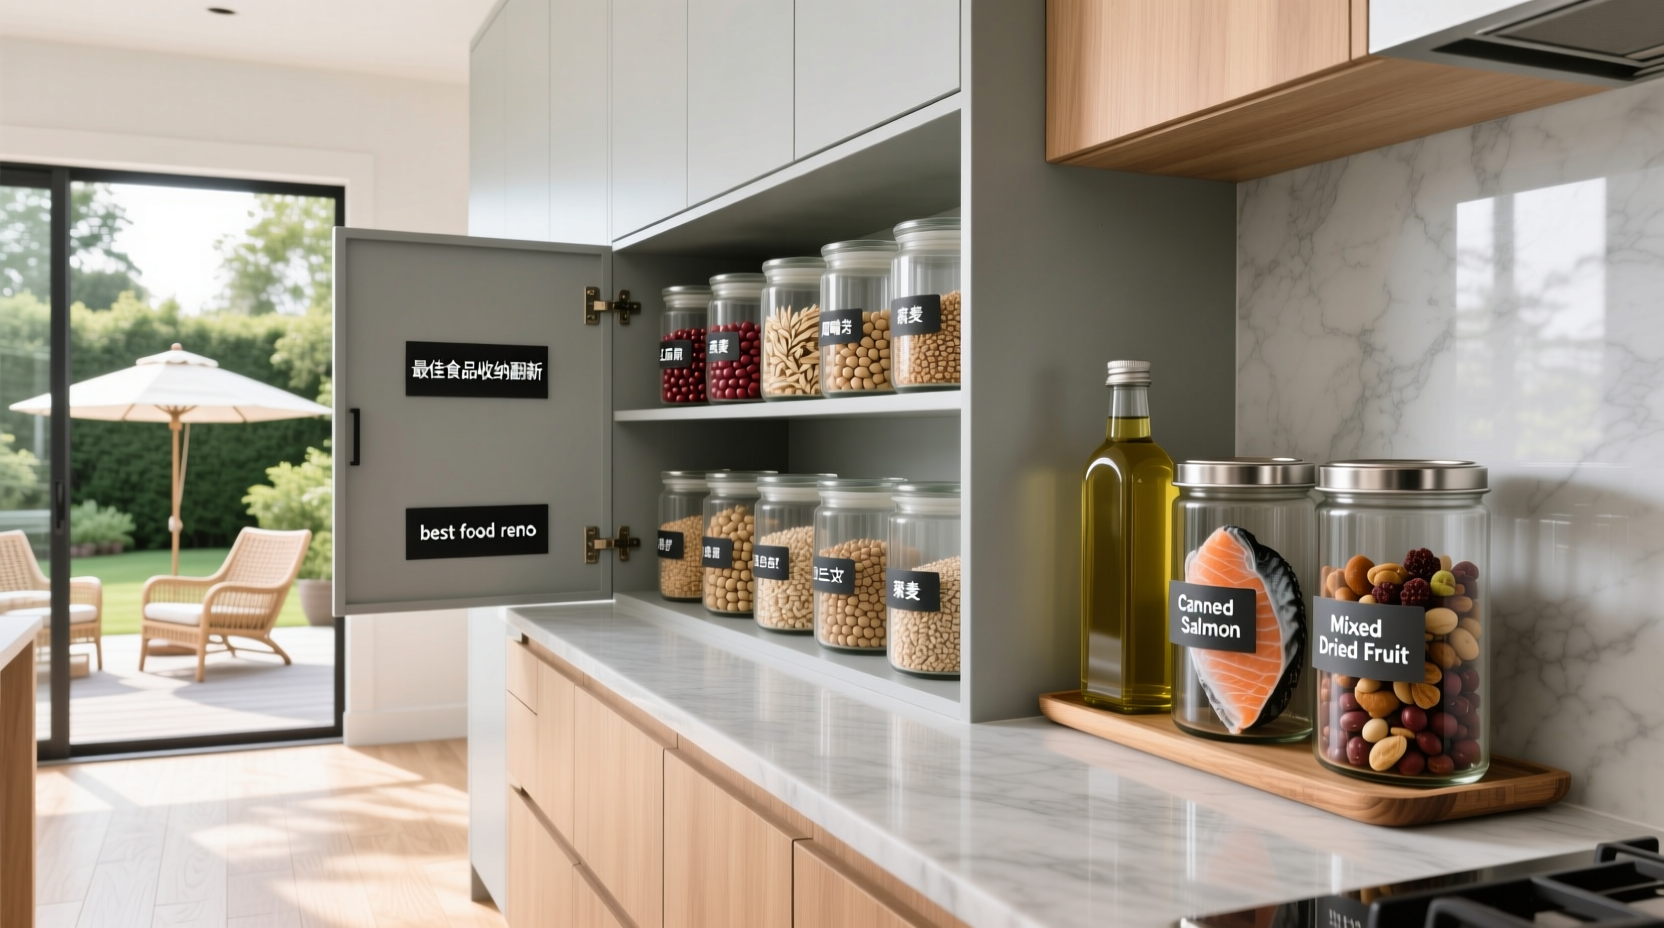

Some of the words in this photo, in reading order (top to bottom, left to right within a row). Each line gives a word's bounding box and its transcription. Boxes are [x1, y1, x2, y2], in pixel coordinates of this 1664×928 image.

[411, 359, 543, 381] 最佳食品收纳翻新
[420, 524, 456, 541] best
[459, 522, 495, 540] food
[500, 524, 537, 538] reno
[1178, 593, 1234, 617] Canned
[1180, 615, 1241, 639] Salmon
[1330, 613, 1382, 639] Mixed
[1319, 635, 1358, 660] Dried
[1364, 641, 1410, 665] Fruit
